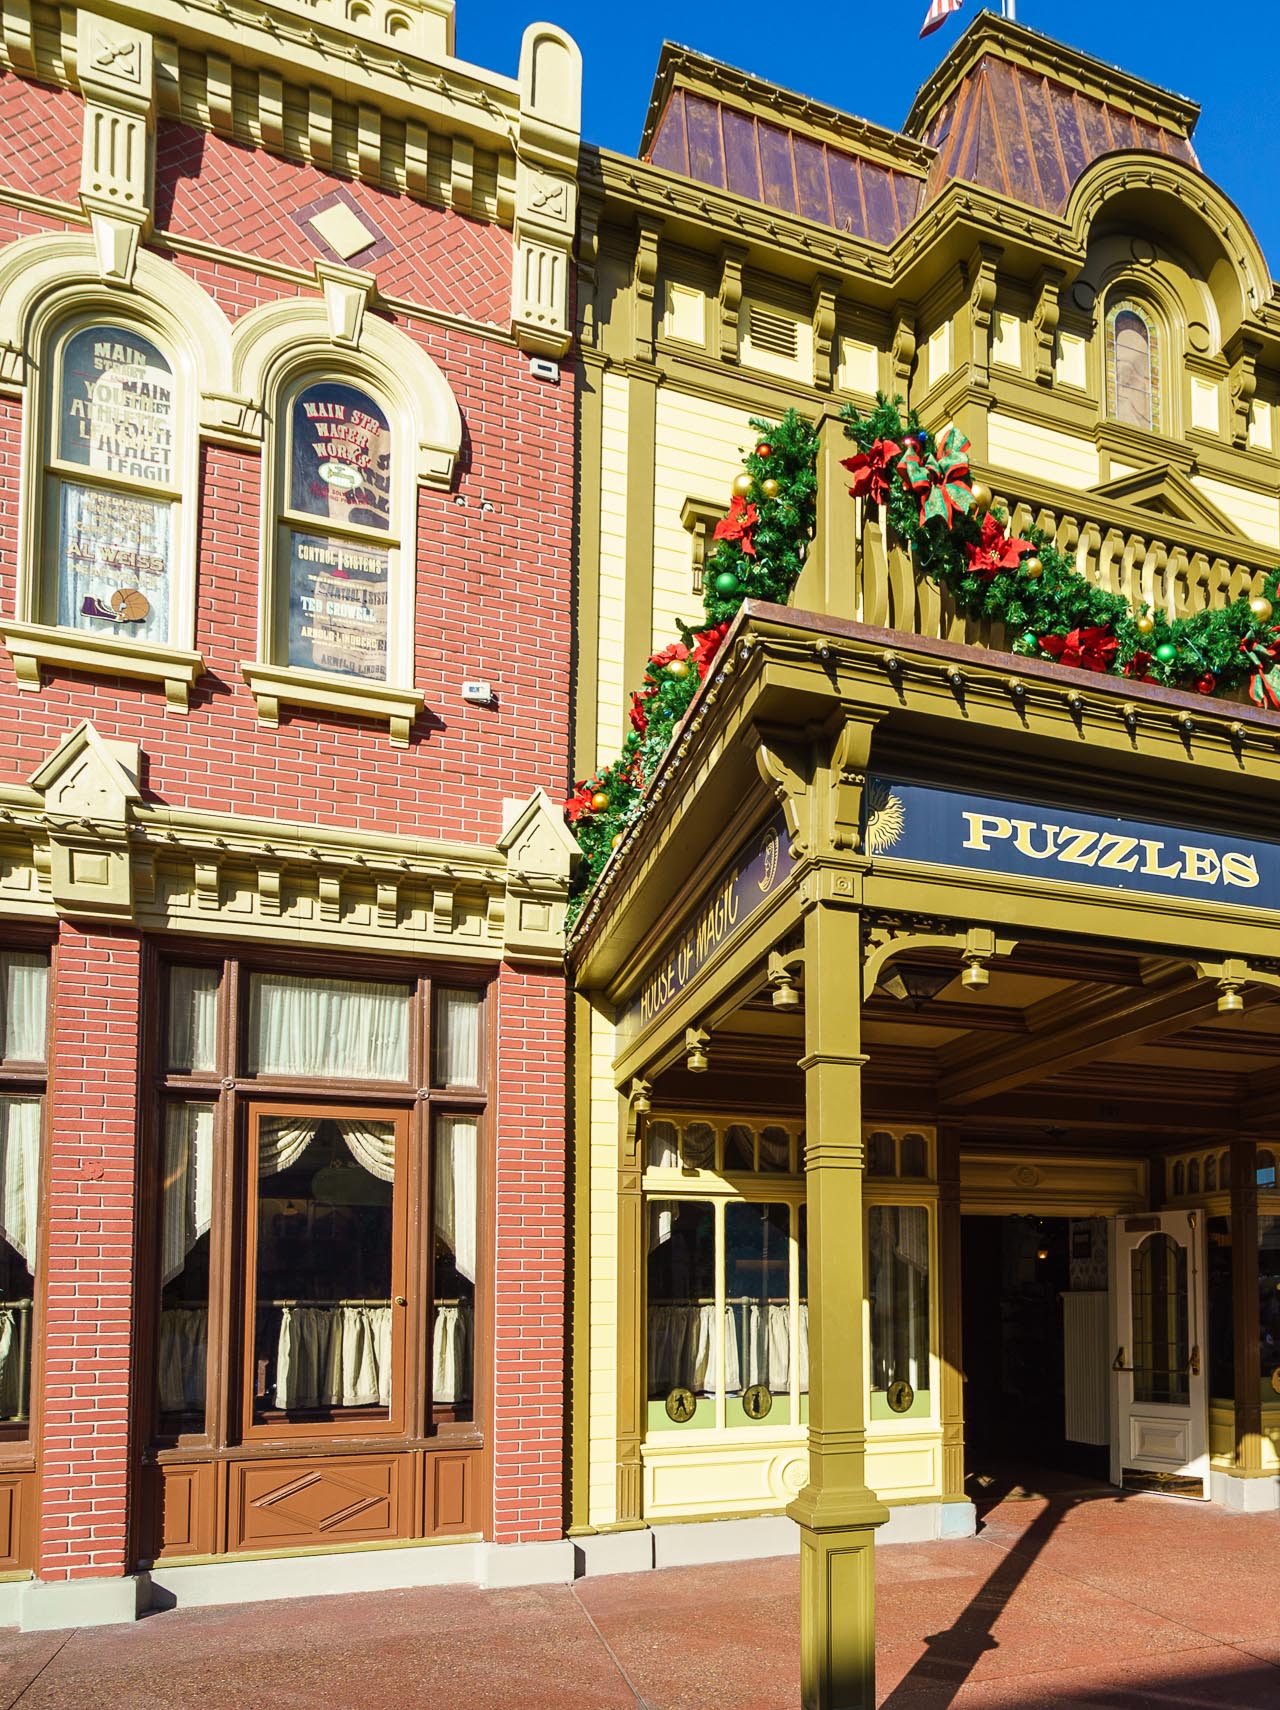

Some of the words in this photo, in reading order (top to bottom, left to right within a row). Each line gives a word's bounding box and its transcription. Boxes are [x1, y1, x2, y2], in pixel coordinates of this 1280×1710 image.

[94, 341, 147, 366] MAIN
[303, 402, 346, 421] MAIN
[314, 422, 369, 450] WATER
[312, 442, 371, 471] WORKS
[66, 541, 96, 560] AL
[99, 546, 165, 573] WEISS
[297, 544, 336, 566] CONTROL
[343, 553, 382, 575] SYSTEMS
[300, 595, 323, 614] TED
[300, 625, 335, 643] ARNOLD
[961, 811, 1260, 888] PUZZLES
[640, 949, 676, 1027] HOUSE
[676, 926, 695, 987] OF
[694, 867, 740, 969] MAGIC
